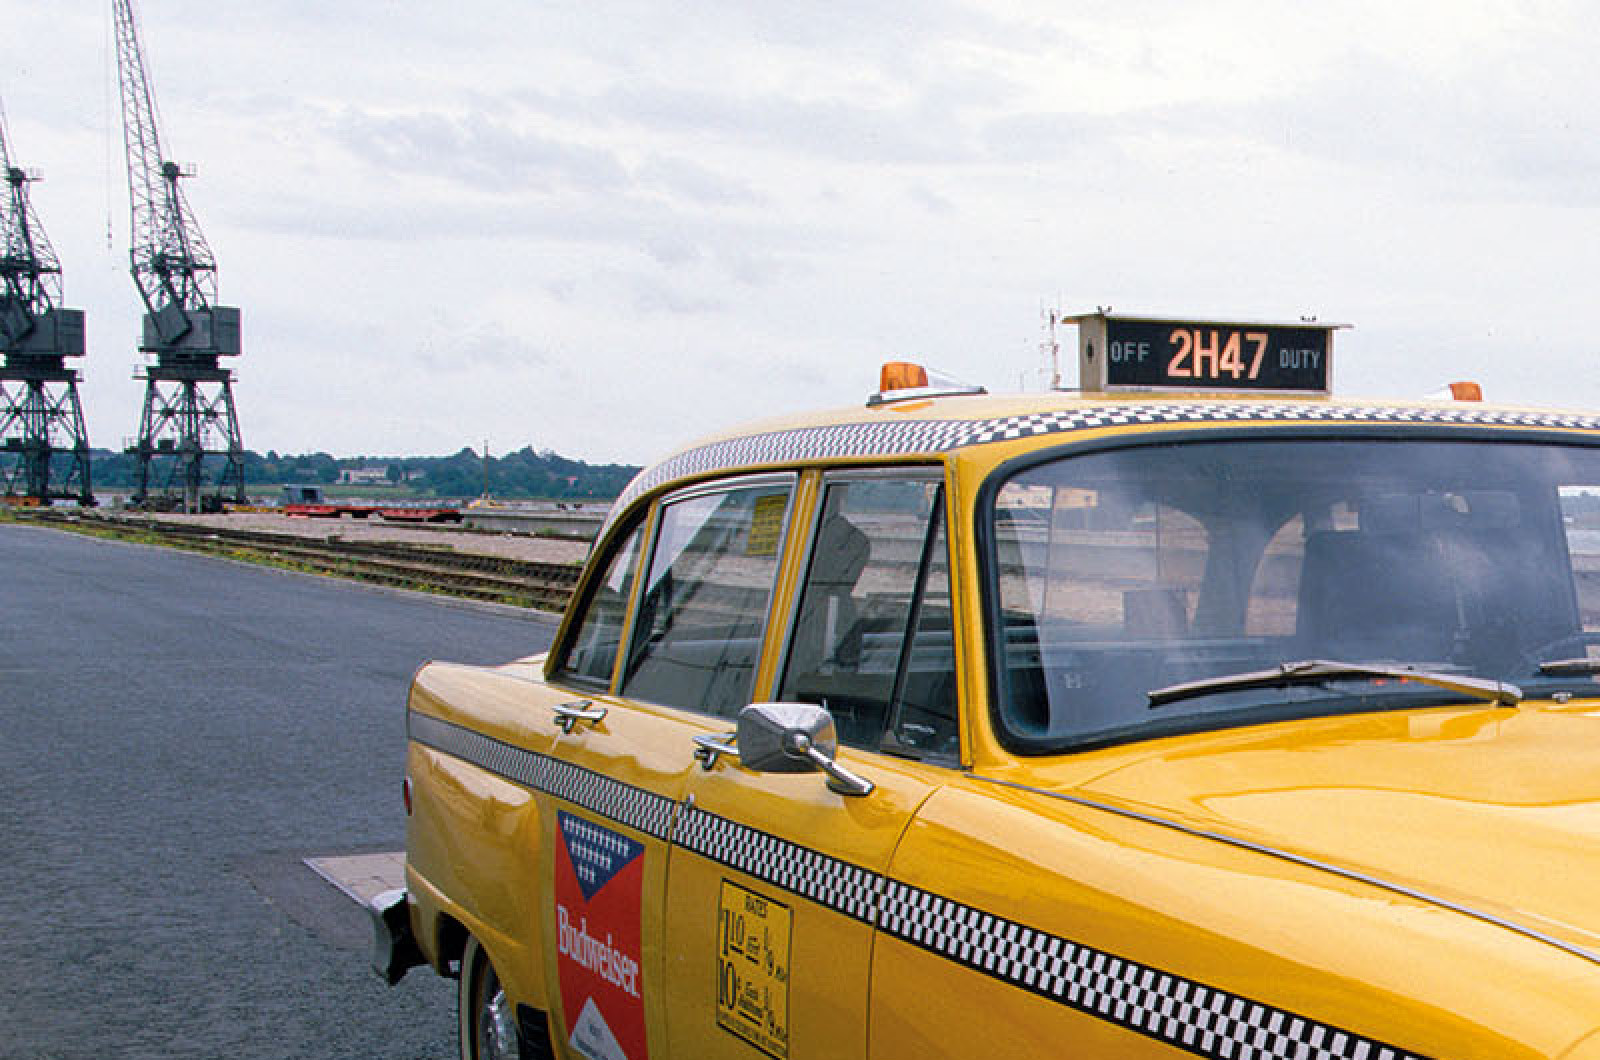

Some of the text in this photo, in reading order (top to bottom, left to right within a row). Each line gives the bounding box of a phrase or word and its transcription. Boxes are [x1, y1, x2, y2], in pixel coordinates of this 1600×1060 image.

[1110, 328, 1321, 380] OFF 2H47 DUTY
[557, 904, 640, 998] Budweiser
